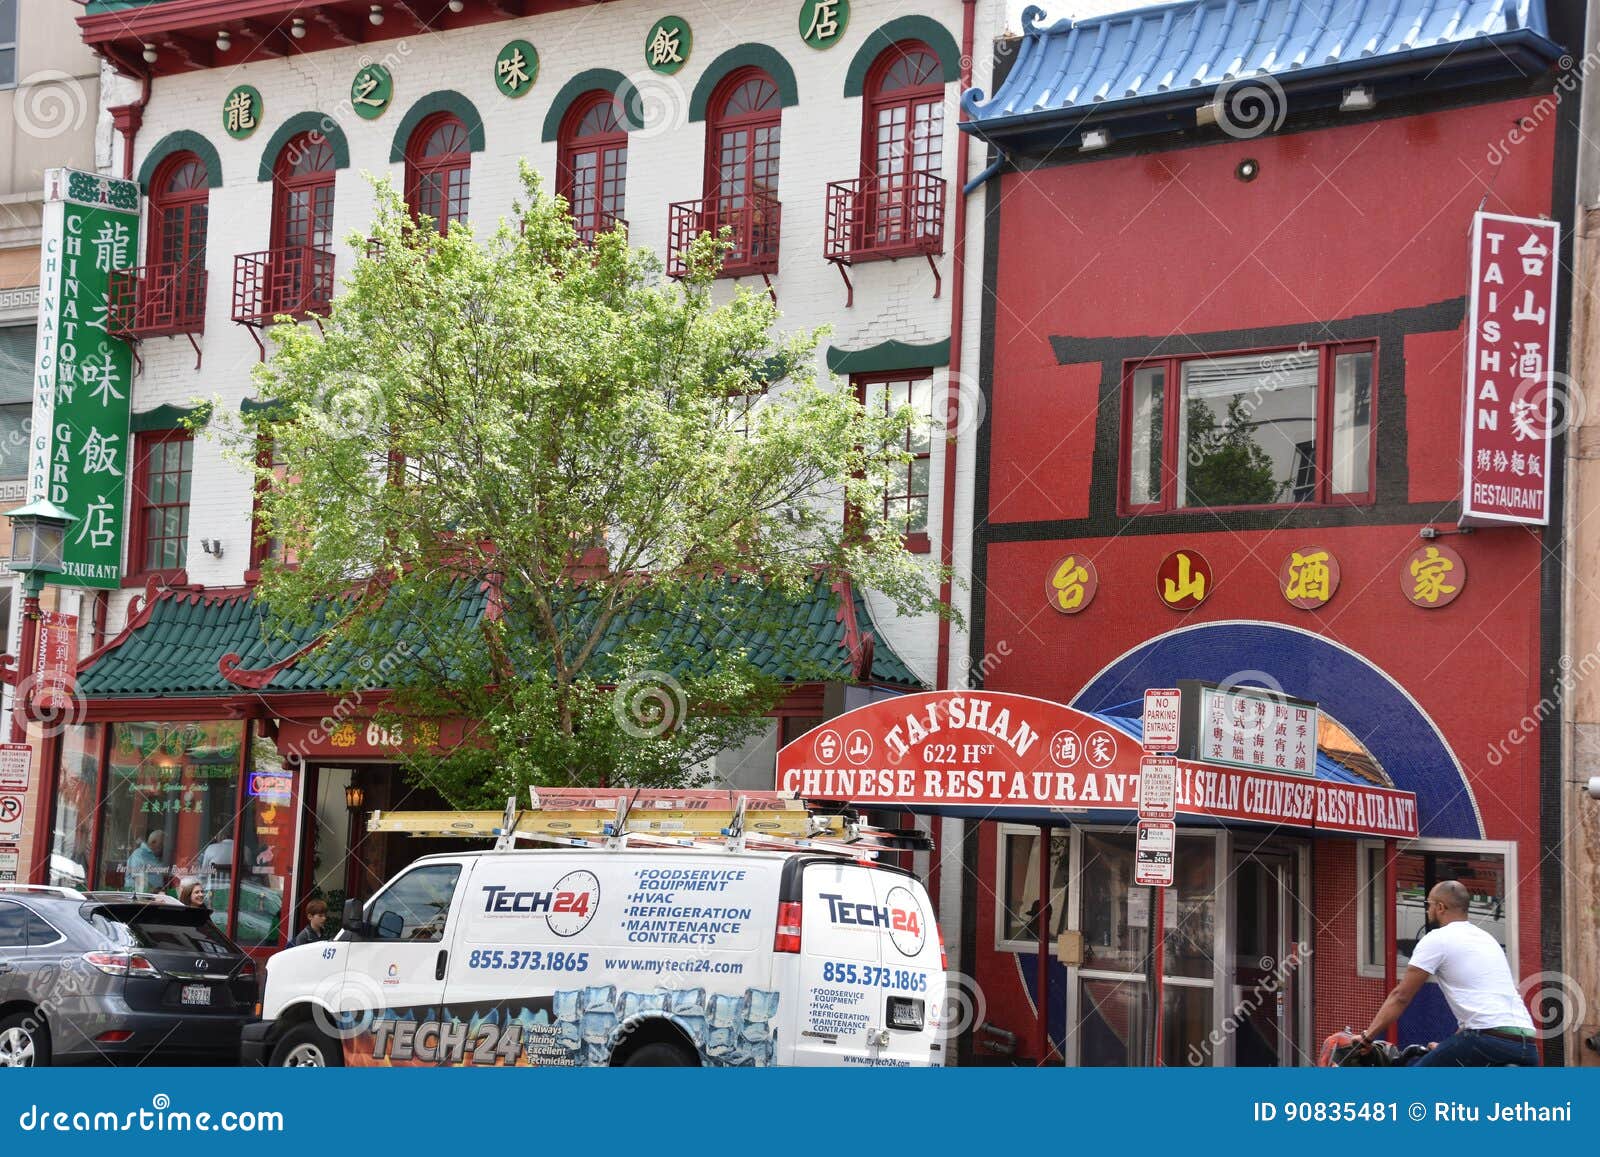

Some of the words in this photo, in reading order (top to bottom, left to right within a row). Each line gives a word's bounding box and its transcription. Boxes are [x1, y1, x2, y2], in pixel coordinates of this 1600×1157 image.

[57, 215, 82, 404] CHINATOWN
[38, 239, 57, 409] CHINATOWN
[1478, 232, 1505, 431] TAISHAN
[1508, 233, 1548, 442] 台山酒家
[52, 423, 72, 511] GARD
[1474, 483, 1544, 510] RESTAURANT
[61, 561, 118, 579] STAURANT
[1156, 698, 1169, 708] NO
[1147, 710, 1177, 720] PARKING
[884, 702, 941, 758] TAI
[948, 697, 1039, 758] SHAN
[1147, 722, 1176, 732] ENTRANCE
[818, 734, 869, 758] 台山
[1054, 736, 1113, 763] 酒家
[923, 744, 957, 763] 622
[783, 769, 915, 798] CHINESE
[1194, 769, 1243, 812] SHAN
[1243, 776, 1314, 820] CHINESE
[1316, 786, 1415, 833] RESTAURANT
[1141, 829, 1146, 839] 2
[639, 869, 746, 881] FOODSERVICE
[639, 880, 729, 892] EQUIPMENT
[633, 892, 674, 904] HVAC
[629, 906, 752, 920] REFRIGERATION
[627, 920, 741, 934] MAINTENANCE
[628, 932, 716, 944] CONTRACTS
[322, 948, 337, 960] 457
[469, 950, 589, 972] 855.373.1865
[605, 959, 743, 974] www.mytech24.com
[823, 962, 927, 992] 855.373.1865
[813, 988, 865, 1000] FOODSERVICE
[815, 995, 858, 1005] EQUIPMENT
[813, 1002, 834, 1010] HVAC
[813, 1010, 870, 1021] REFRIGERATION
[530, 1023, 562, 1036] Always
[812, 1018, 866, 1029] MAINTENANCE
[813, 1025, 857, 1035] CONTRACTS
[372, 1020, 524, 1064] TECH-24
[529, 1035, 556, 1048] Hiring
[528, 1046, 566, 1056] Excellent
[527, 1056, 575, 1066] Technicians
